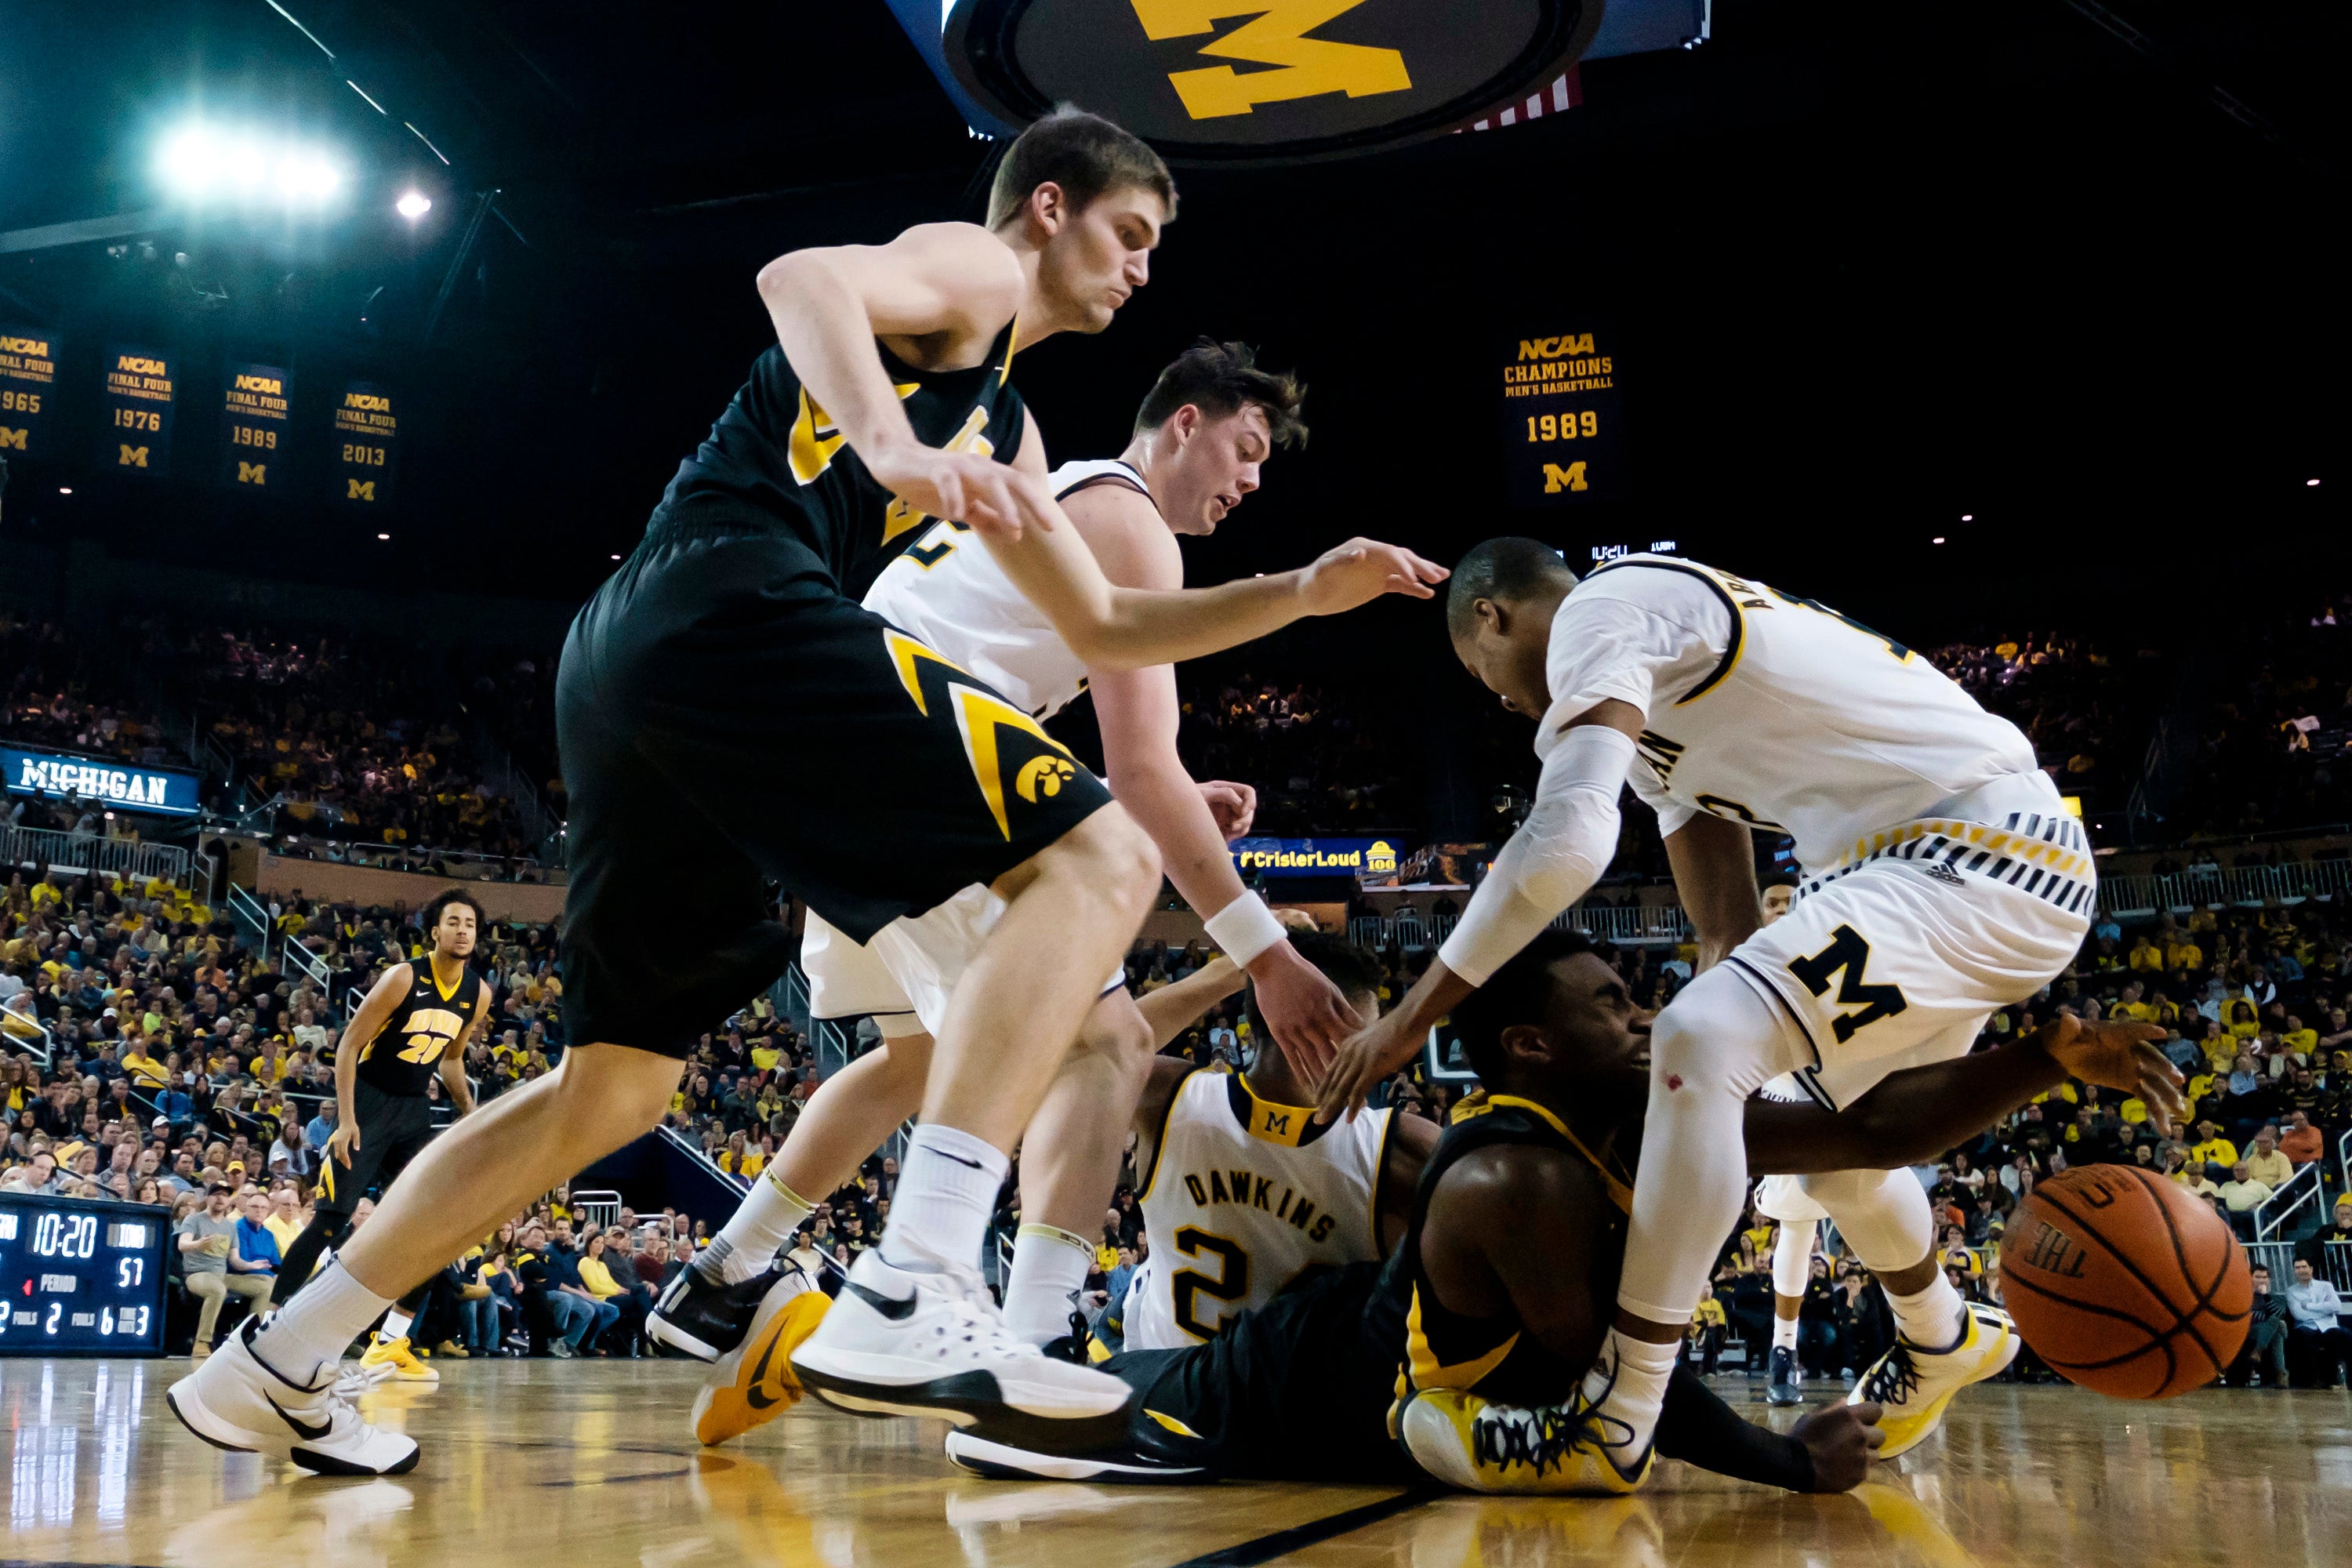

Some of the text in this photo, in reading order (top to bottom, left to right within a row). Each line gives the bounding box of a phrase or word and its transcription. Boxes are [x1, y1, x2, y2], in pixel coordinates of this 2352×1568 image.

[1131, 0, 1412, 119] M
[0, 336, 48, 357] NCAA
[1518, 333, 1595, 361] NCAA
[24, 358, 54, 374] FOUR
[118, 355, 165, 376] NCAA
[1504, 357, 1613, 384] CHAMPIONS
[108, 372, 172, 392] FINAL FOUR
[235, 375, 281, 395] NCAA
[1505, 377, 1613, 397] MEN'S BASKETBALL
[2, 390, 41, 414] 965
[226, 390, 288, 410] FINAL FOUR
[344, 393, 390, 412] NCAA
[115, 408, 161, 431] 1976
[336, 408, 396, 428] FINAL FOUR
[1527, 411, 1598, 442] 1989
[234, 426, 277, 449] 1989
[118, 444, 149, 468] M
[343, 444, 385, 466] 2013
[238, 461, 266, 485] M
[1543, 461, 1588, 493] M
[347, 478, 376, 501] M
[20, 758, 168, 805] MICHIGAN
[1367, 859, 1396, 870] 100
[1926, 869, 1965, 885] adidas
[1786, 923, 1908, 1045] M
[1264, 1111, 1290, 1136] M
[1184, 1170, 1335, 1243] DAWKINS
[33, 1213, 97, 1258] 10:20
[40, 1273, 77, 1293] PERIOD
[118, 1257, 143, 1287] 57
[1173, 1224, 1248, 1343] 2
[45, 1302, 62, 1334] 2
[100, 1306, 114, 1335] 6
[136, 1305, 150, 1336] 3
